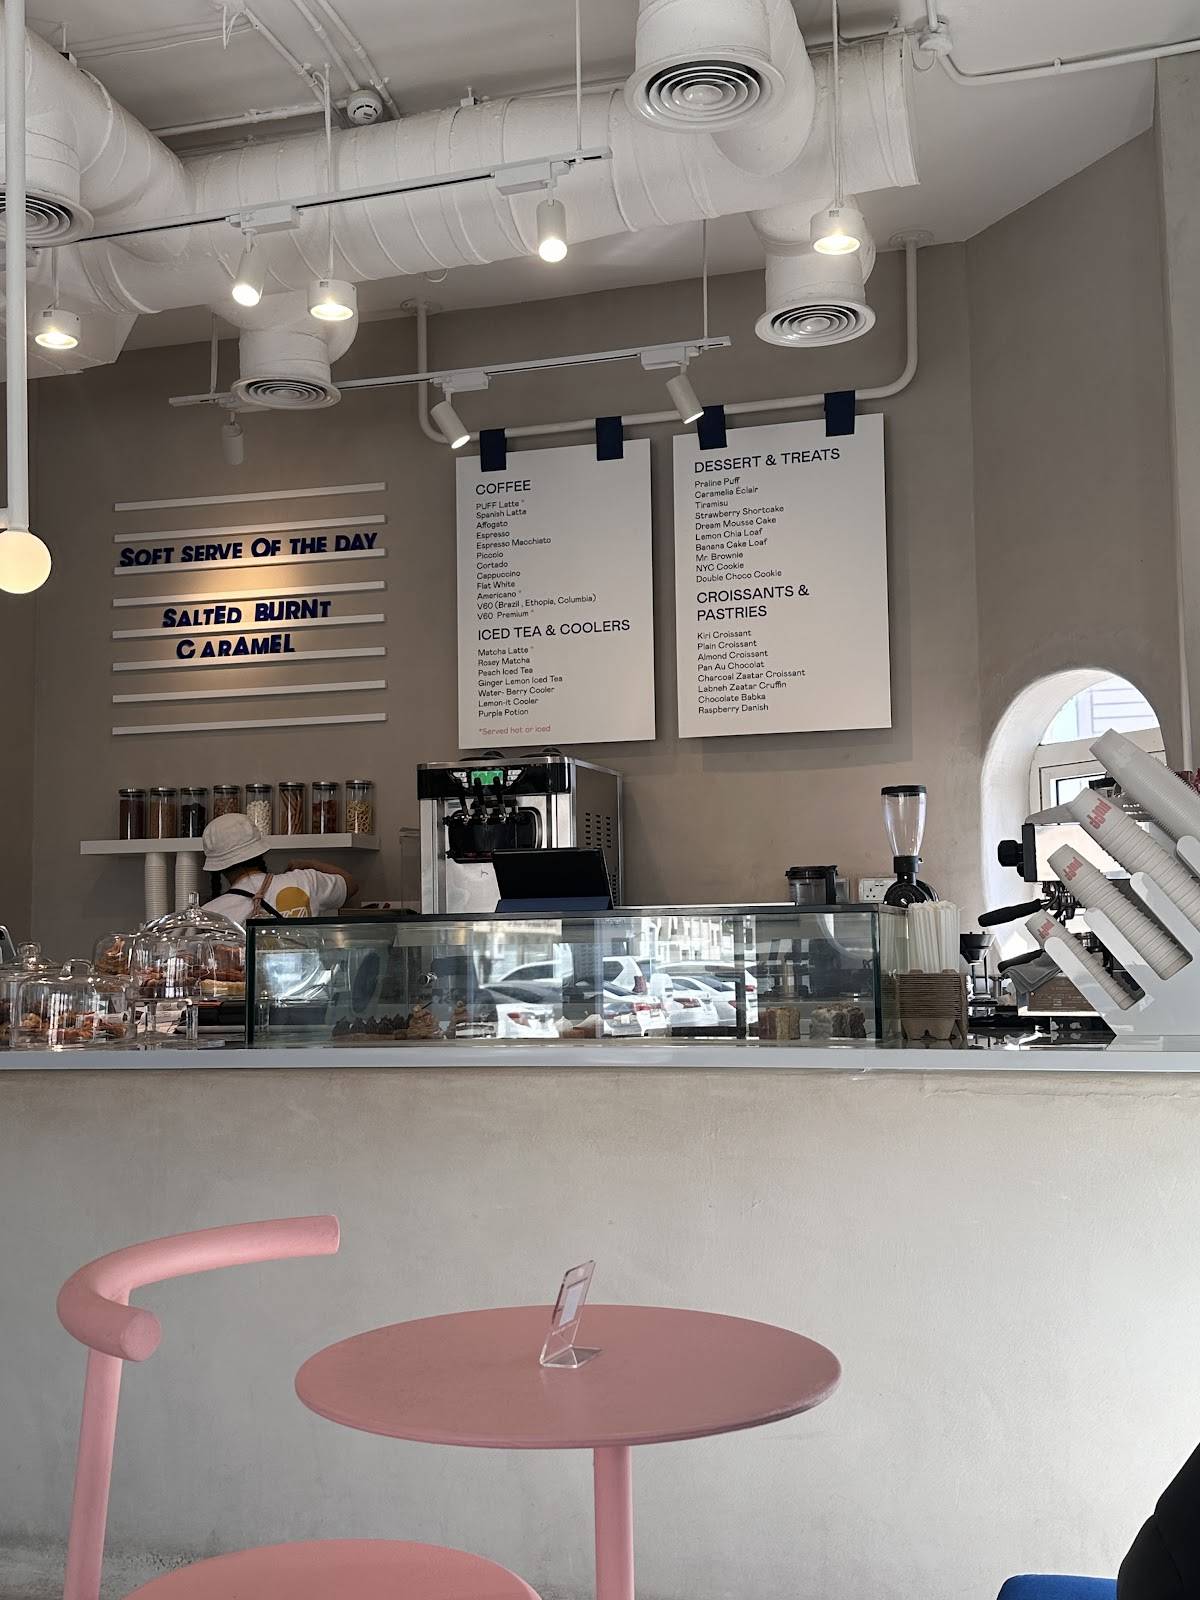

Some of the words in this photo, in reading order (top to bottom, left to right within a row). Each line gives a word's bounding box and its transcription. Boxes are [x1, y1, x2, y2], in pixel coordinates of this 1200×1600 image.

[695, 455, 761, 473] DESSERT
[765, 455, 776, 466] &
[781, 448, 840, 465] TREATS
[475, 480, 531, 495] COFFEE
[695, 480, 722, 488] Praline
[723, 477, 740, 485] Puff
[476, 501, 497, 510] PUFF
[695, 500, 728, 508] Tiramisu
[476, 510, 505, 519] Spanish
[695, 509, 741, 519] Strawberry
[742, 505, 784, 515] Shortcake
[476, 520, 508, 530] Affogato
[695, 521, 721, 530] Dream
[723, 519, 754, 528] Mousse
[756, 516, 776, 525] Cake
[476, 530, 510, 540] Espresso
[695, 532, 722, 540] Lemon
[723, 530, 742, 538] Chia
[744, 528, 763, 536] Loaf
[476, 540, 510, 550] Espresso
[512, 537, 551, 545] Macchiato
[695, 542, 725, 551] Banana
[726, 540, 747, 549] Cake
[748, 538, 768, 547] Loaf
[120, 547, 175, 567] SOFT
[181, 543, 243, 562] SERVE
[251, 538, 281, 557] OF
[289, 536, 327, 554] THE
[335, 533, 378, 552] DAY
[476, 551, 504, 559] Piccolo
[711, 552, 744, 560] Brownie
[476, 561, 509, 570] Cortado
[696, 564, 715, 572] NYC
[716, 562, 744, 570] Cookie
[476, 570, 521, 581] Cappuccino
[696, 574, 723, 583] Double
[725, 572, 752, 580] Choco
[754, 570, 782, 578] Cookie
[697, 586, 794, 603] CROISSANTS
[798, 584, 810, 596] &
[477, 601, 493, 610] V60
[163, 606, 242, 627] SALTED
[254, 599, 332, 621] BURNT
[477, 611, 493, 620] V60
[697, 605, 767, 622] PASTRIES
[478, 628, 510, 640] ICED
[514, 626, 542, 638] TEA
[545, 624, 556, 636] &
[560, 619, 630, 634] COOLERS
[697, 632, 711, 640] Kiri
[712, 630, 751, 638] Croissant
[176, 634, 296, 659] CARAMEL
[698, 642, 716, 650] Plain
[718, 640, 757, 649] Croissant
[478, 648, 507, 657] Matcha
[698, 652, 727, 661] Almond
[729, 650, 768, 659] Croissant
[478, 659, 500, 668] Rosey
[501, 657, 530, 665] Matcha
[698, 663, 713, 671] Pan
[728, 661, 765, 669] Chocolat
[478, 669, 501, 677] Peach
[698, 673, 734, 682] Charcoal
[736, 672, 763, 680] Zaatar
[765, 669, 806, 678] Croissant
[478, 679, 503, 688] Ginger
[505, 677, 530, 685] Lemon
[698, 684, 727, 693] Labneh
[729, 682, 757, 691] Zaatar
[506, 688, 527, 696] Berry
[529, 686, 554, 694] Cooler
[513, 697, 538, 705] Cooler
[698, 694, 739, 704] Chocolate
[741, 693, 766, 701] Babka
[478, 710, 502, 718] Purple
[504, 708, 528, 716] Potion
[698, 705, 740, 715] Raspberry
[741, 703, 769, 712] Danish
[510, 726, 523, 734] hot
[525, 726, 533, 734] or
